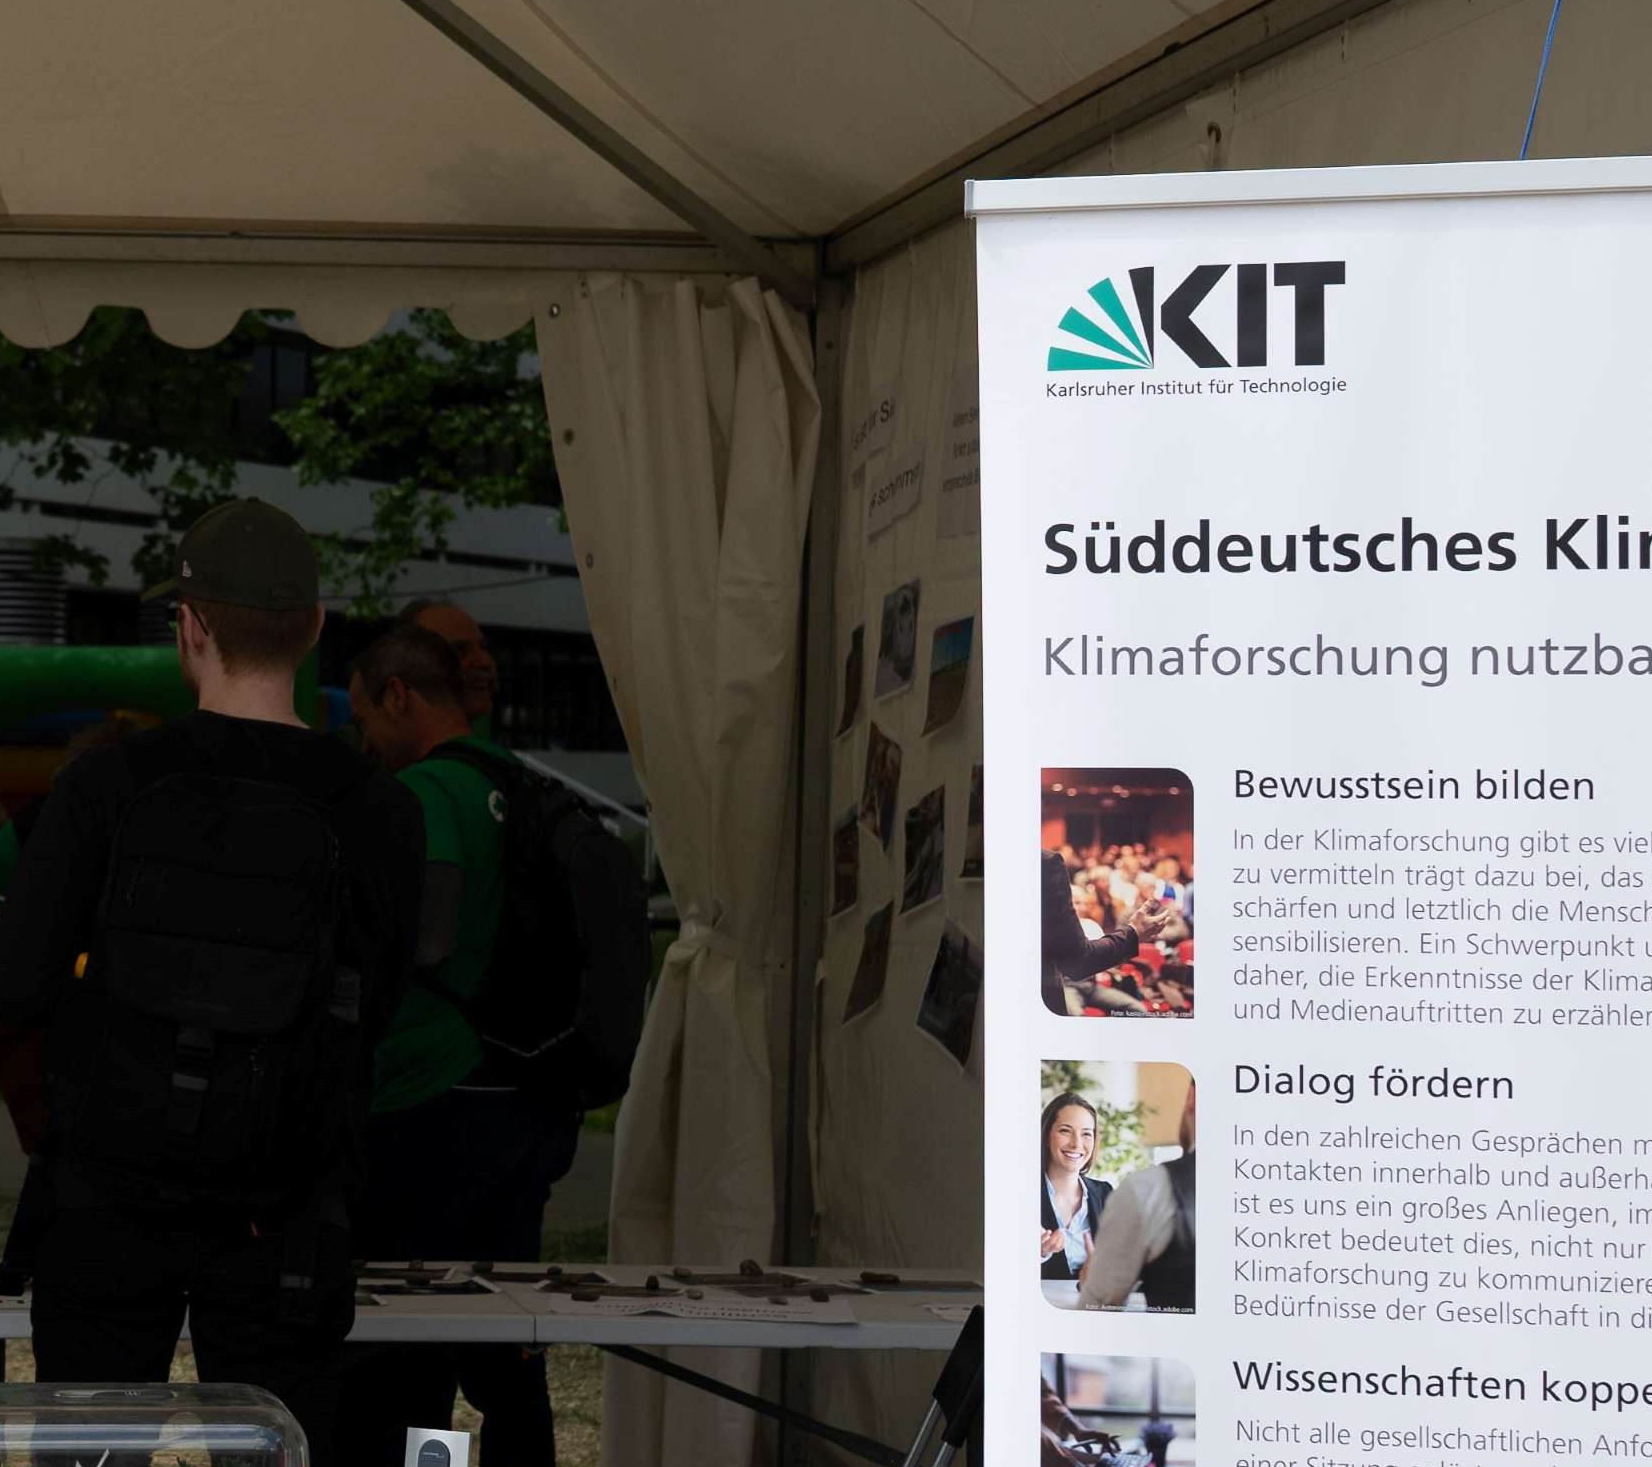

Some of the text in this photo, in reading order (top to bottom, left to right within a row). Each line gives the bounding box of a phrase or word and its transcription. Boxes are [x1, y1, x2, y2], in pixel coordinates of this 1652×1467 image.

[1129, 261, 1346, 370] KIT
[1047, 377, 1346, 397] Karlsruher Institut für Technologie
[1045, 517, 1516, 574] Süddeutsches
[1046, 634, 1447, 687] Klimaforschung
[1235, 769, 1594, 800] Bewusstsein bilden
[1234, 828, 1253, 850] In
[1264, 828, 1304, 850] der
[1315, 828, 1509, 858] Klimaforschung
[1520, 830, 1570, 858] gibt
[1579, 837, 1604, 853] es
[1233, 868, 1260, 884] zu
[1270, 863, 1394, 885] vermitteln
[1405, 865, 1466, 891] trägt
[1475, 863, 1534, 887] dazu
[1546, 864, 1589, 891] bei,
[1601, 865, 1643, 888] das
[1233, 896, 1337, 919] schärfen
[1349, 896, 1394, 919] und
[1406, 897, 1500, 921] letztlich
[1512, 898, 1548, 921] die
[1233, 930, 1408, 953] sensibilisieren.
[1421, 932, 1455, 954] Ein
[1467, 932, 1636, 962] Schwerpunkt
[1236, 1064, 1513, 1104] Dialog fördern
[1232, 1361, 1525, 1400] Wissenschaften
